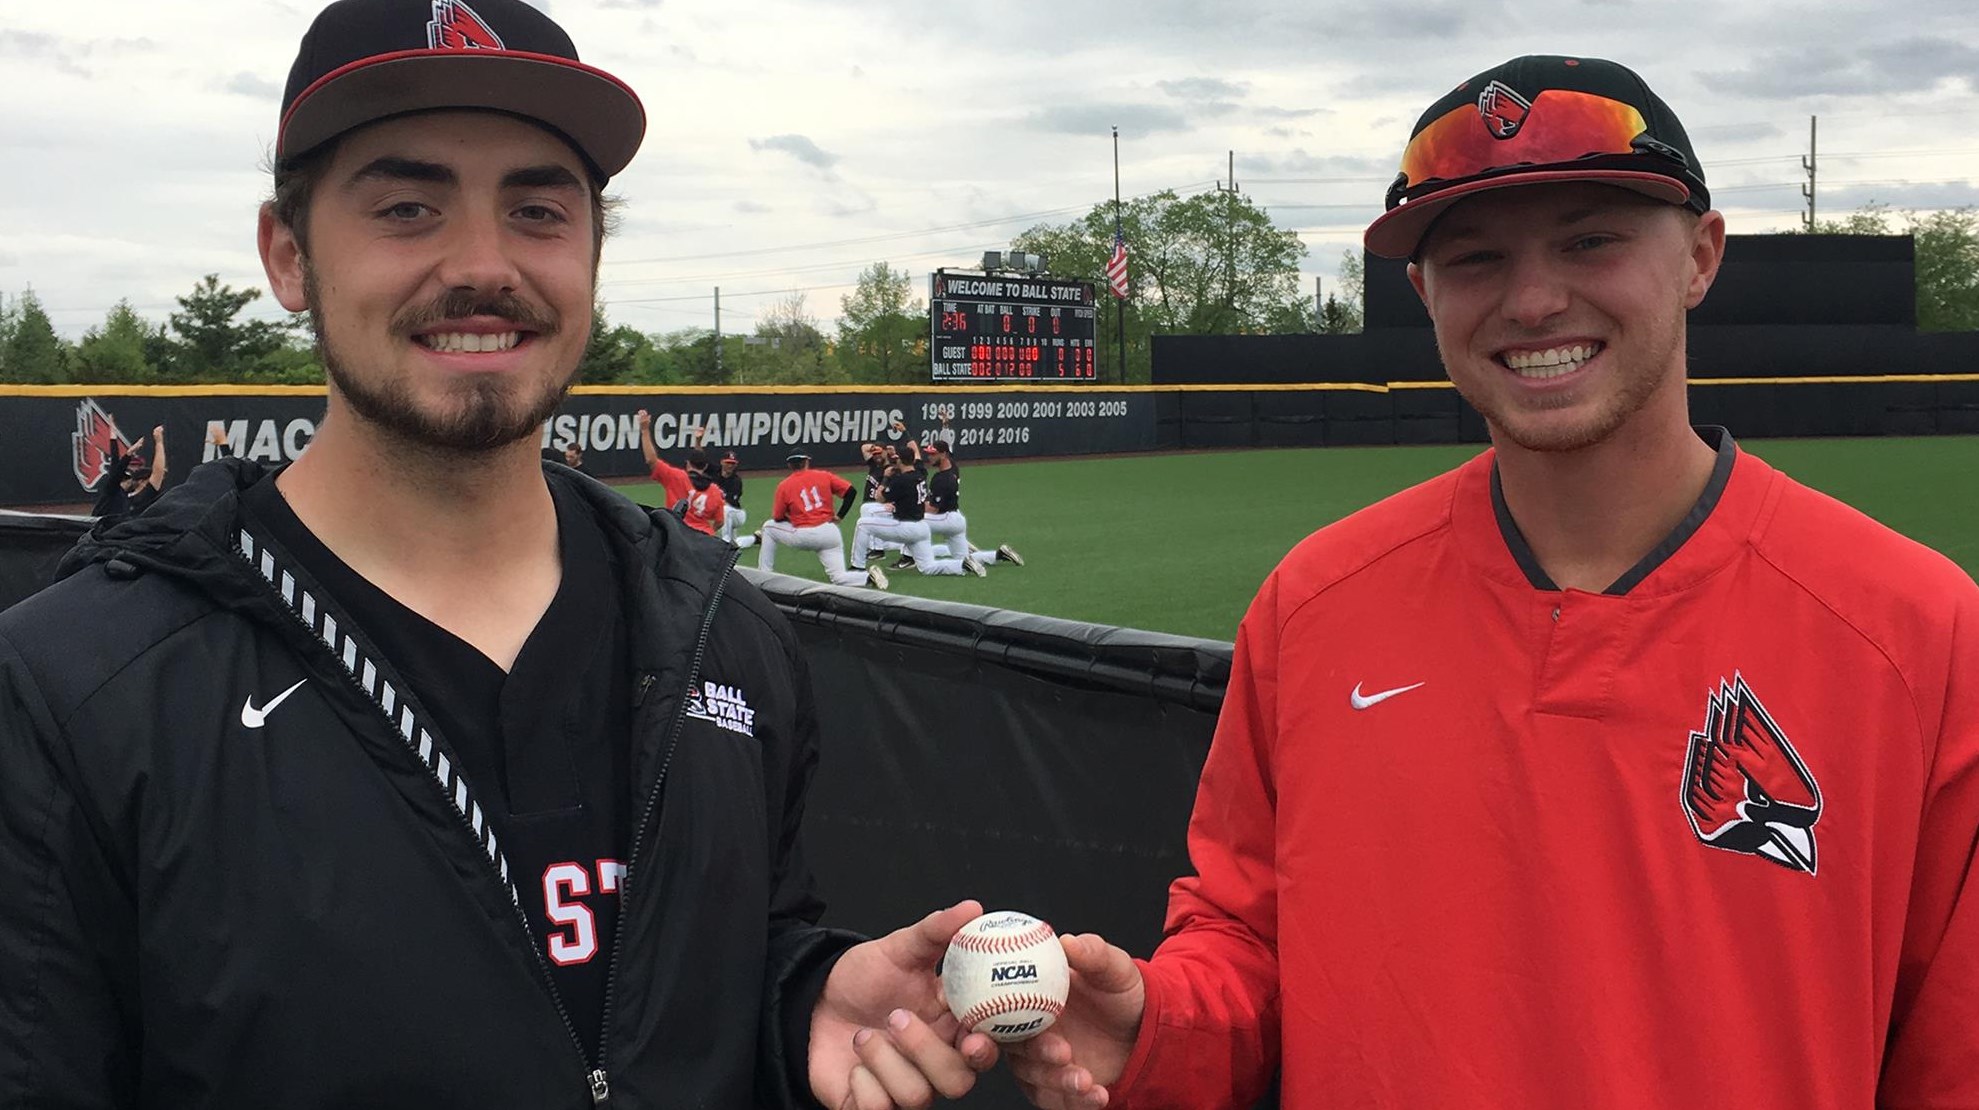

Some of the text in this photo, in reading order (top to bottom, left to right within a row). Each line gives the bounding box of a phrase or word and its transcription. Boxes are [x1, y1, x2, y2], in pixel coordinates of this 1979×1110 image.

[947, 280, 1082, 301] WELCOME TO BALL STATE
[943, 302, 957, 313] TIME
[977, 304, 995, 314] AT BAT
[1000, 305, 1013, 315] BALL
[1022, 306, 1040, 317] STRIKE
[1050, 307, 1061, 317] OUT
[942, 312, 967, 331] 2:36
[1003, 315, 1010, 332] 0
[1028, 316, 1035, 333] 0
[942, 346, 966, 359] GUEST
[933, 362, 971, 376] BALL STATE
[921, 401, 1128, 420] 1998 1999 2000 2001 2003 2005
[202, 419, 316, 464] MAC
[654, 409, 904, 450] CHAMPIONSHIPS
[920, 427, 1029, 446] 209 2014 2016
[800, 486, 822, 512] 11
[916, 480, 928, 505] 15
[687, 489, 708, 516] 14
[705, 681, 746, 706] BALL
[706, 698, 755, 726] STATE
[716, 716, 754, 737] BASEBALL
[991, 964, 1037, 982] NCAA
